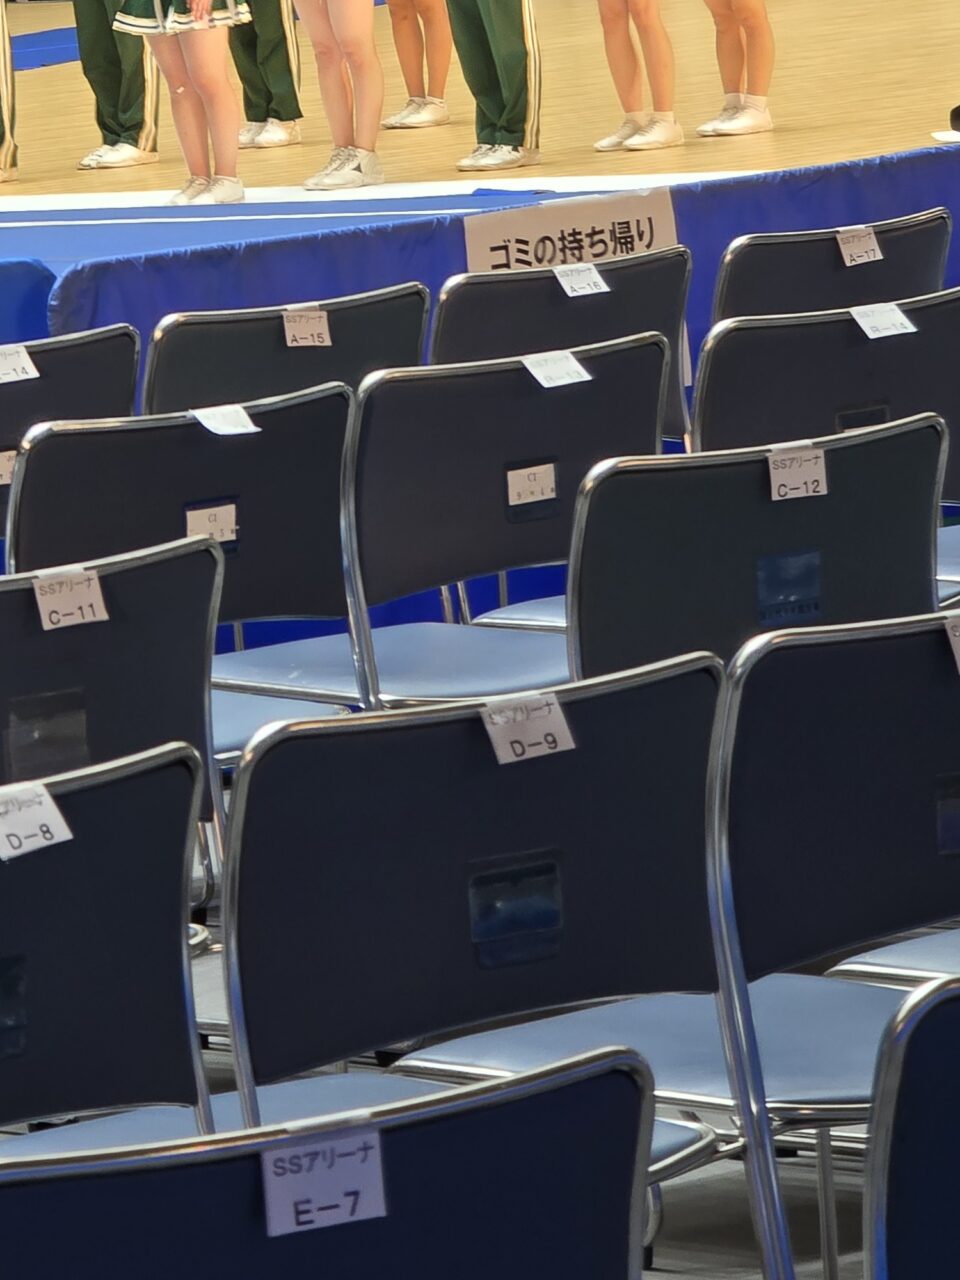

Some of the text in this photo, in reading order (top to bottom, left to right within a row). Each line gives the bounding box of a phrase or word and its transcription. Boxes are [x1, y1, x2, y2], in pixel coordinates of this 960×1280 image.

[490, 217, 655, 270] ゴミの持ち帰り
[849, 248, 877, 264] A-17
[570, 281, 602, 294] A-16
[291, 333, 325, 345] A-15
[772, 455, 821, 470] SSアリーナ
[777, 479, 821, 498] C-12
[48, 602, 97, 625] C-11
[510, 732, 558, 758] D-9
[5, 823, 55, 851] D-8
[272, 1141, 375, 1178] SSアリーナ
[292, 1190, 361, 1227] E-7
